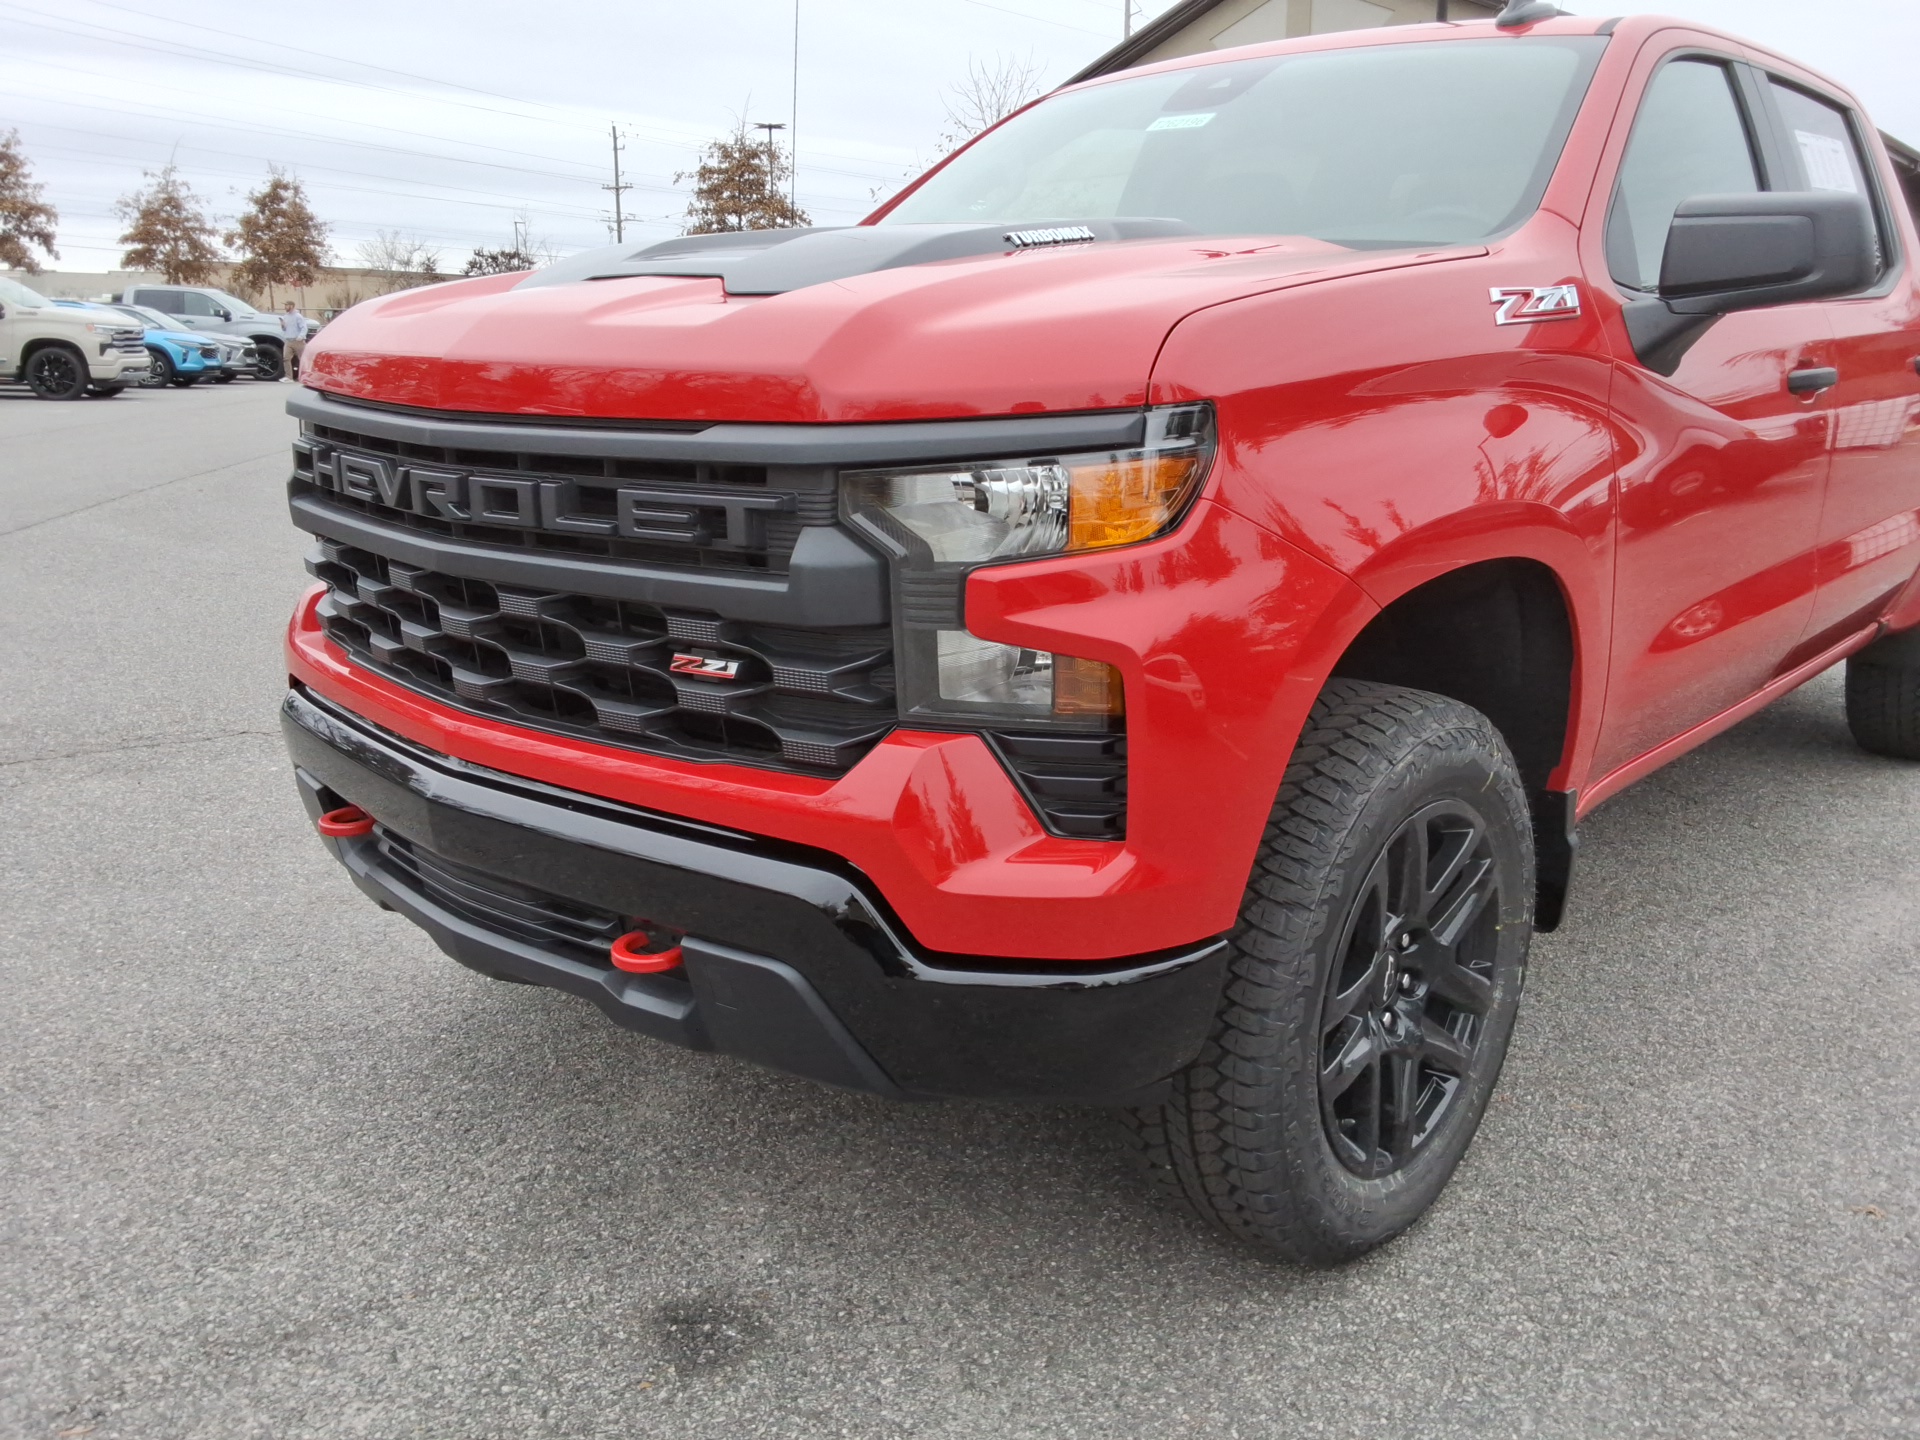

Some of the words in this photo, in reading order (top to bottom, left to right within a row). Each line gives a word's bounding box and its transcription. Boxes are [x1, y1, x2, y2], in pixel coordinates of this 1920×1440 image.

[1004, 226, 1096, 247] TURBOMAX
[1489, 284, 1581, 325] Z71
[292, 438, 790, 547] CHEVROLET
[669, 653, 739, 679] Z71
